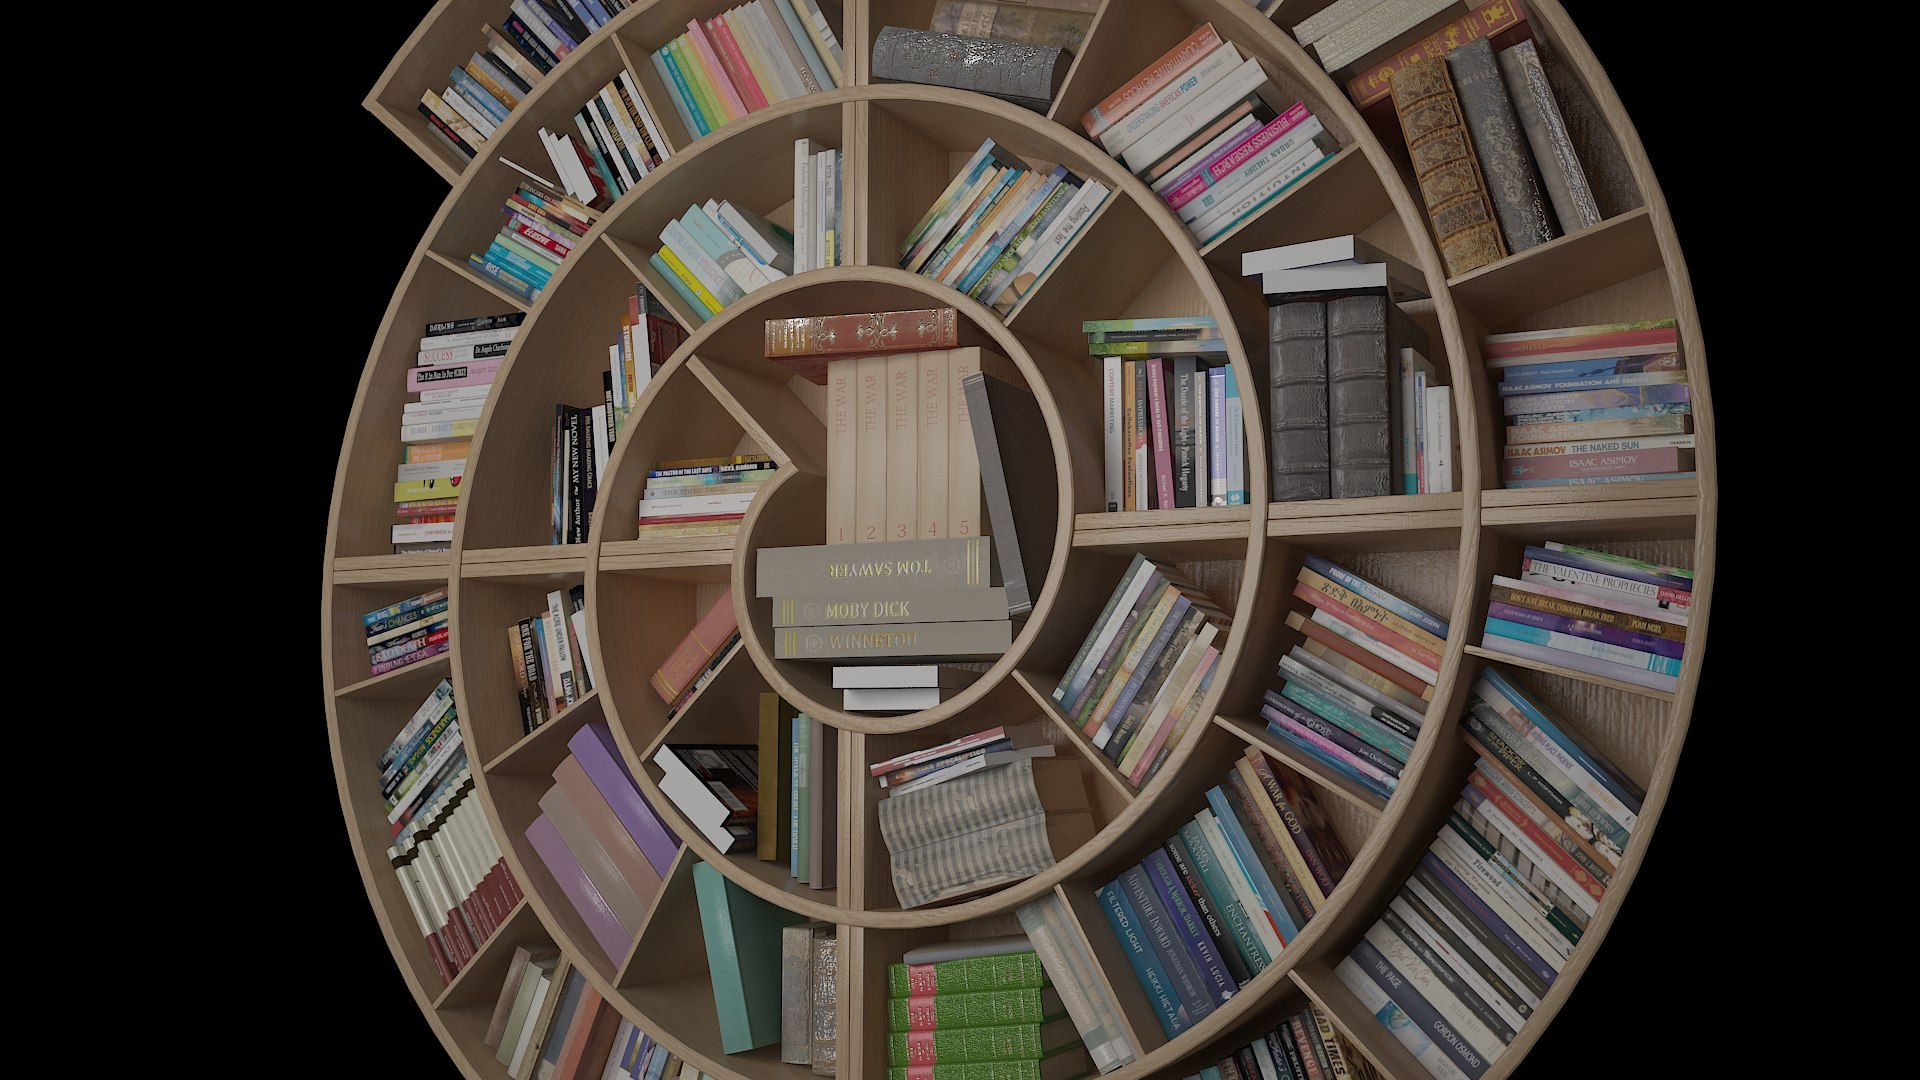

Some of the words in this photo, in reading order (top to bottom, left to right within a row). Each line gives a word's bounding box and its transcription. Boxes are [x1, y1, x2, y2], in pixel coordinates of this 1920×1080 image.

[1150, 40, 1202, 80] QUANTITATIVE
[1119, 72, 1157, 102] METHODS
[1178, 74, 1201, 94] POWER
[1249, 116, 1291, 148] BUSINESS
[1209, 141, 1256, 177] RESEARCH
[1268, 137, 1295, 159] URBAN
[1241, 155, 1270, 178] THEORY
[1229, 161, 1308, 217] INTUITION
[1067, 201, 1090, 225] Passing
[523, 226, 551, 246] ELUSIVE
[1053, 232, 1066, 245] Test
[1062, 222, 1074, 234] the
[999, 247, 1015, 264] JOHN
[484, 261, 500, 275] RISE
[681, 272, 692, 286] YOU
[423, 348, 453, 362] SUCCESS
[866, 373, 877, 405] WAR
[896, 370, 907, 402] WAR
[927, 368, 938, 400] WAR
[1180, 374, 1188, 385] The
[1555, 380, 1602, 388] FOUNDATION
[836, 377, 846, 408] WAR
[836, 410, 846, 436] THE
[866, 407, 877, 432] THE
[896, 404, 907, 430] THE
[927, 401, 938, 428] THE
[956, 399, 968, 424] THE
[1180, 415, 1189, 424] the
[1507, 447, 1531, 457] ISAAC
[1533, 446, 1566, 456] ASIMOV
[1571, 445, 1589, 453] THE
[1589, 443, 1619, 452] NAKED
[1621, 441, 1639, 450] SUN
[1570, 459, 1596, 467] ISAAC
[1600, 455, 1638, 464] ASIMOV
[572, 469, 578, 483] MY
[1604, 475, 1644, 483] ASIMOV
[838, 528, 844, 541] 1
[866, 526, 876, 540] 2
[897, 524, 907, 539] 3
[928, 522, 937, 536] 4
[960, 521, 969, 535] 5
[829, 562, 892, 578] SAWYER
[896, 560, 932, 577] TOM
[1328, 566, 1345, 580] PROOF
[1343, 574, 1351, 583] OF
[1533, 562, 1550, 573] THE
[1552, 566, 1600, 585] VALENTINE
[1602, 575, 1656, 596] PROPHECIES
[386, 611, 418, 627] CHANCES
[551, 603, 559, 613] THE
[826, 601, 868, 620] MOBY
[872, 599, 910, 617] DICK
[1408, 608, 1422, 619] GARY
[1420, 615, 1439, 629] JOSEPH
[520, 623, 530, 637] ONE
[552, 613, 561, 627] ACRE
[522, 637, 532, 650] FOR
[555, 627, 564, 642] UNDER
[830, 631, 918, 650] WINNETOU
[524, 649, 534, 664] THE
[1267, 694, 1295, 713] Memories
[1305, 716, 1332, 736] GHOST
[1358, 746, 1370, 757] Joe
[1368, 752, 1397, 772] DeRouen
[1486, 731, 1527, 766] SHADOW
[1496, 748, 1523, 771] PIPER
[1265, 779, 1283, 802] WAR
[1282, 810, 1302, 835] GOD
[1181, 829, 1210, 875] MAXWELL
[1191, 833, 1211, 863] JAMES
[1152, 858, 1172, 887] THROUGH
[1304, 848, 1319, 867] DAN
[1313, 865, 1331, 888] WOLF
[1167, 842, 1183, 863] some
[1177, 861, 1189, 876] are
[1184, 873, 1202, 897] sicker
[1196, 896, 1211, 914] than
[1204, 912, 1223, 937] others
[1124, 871, 1156, 918] ADVENTURE
[1148, 915, 1173, 949] INWARD
[1104, 890, 1130, 929] FILTERED
[1124, 927, 1144, 955] LIGHT
[1196, 940, 1213, 963] KEVIN
[1208, 964, 1226, 988] LUCIA
[1373, 960, 1389, 975] THE
[1383, 970, 1402, 989] PAGE
[1143, 966, 1164, 995] HEIKKI
[1157, 993, 1182, 1030] HIETALA
[1291, 1019, 1318, 1077] REVENGE
[1313, 1007, 1331, 1034] BAD
[1324, 1036, 1346, 1076] TIMES
[1430, 1018, 1459, 1046] GORDON
[1452, 1041, 1482, 1069] OSMOND
